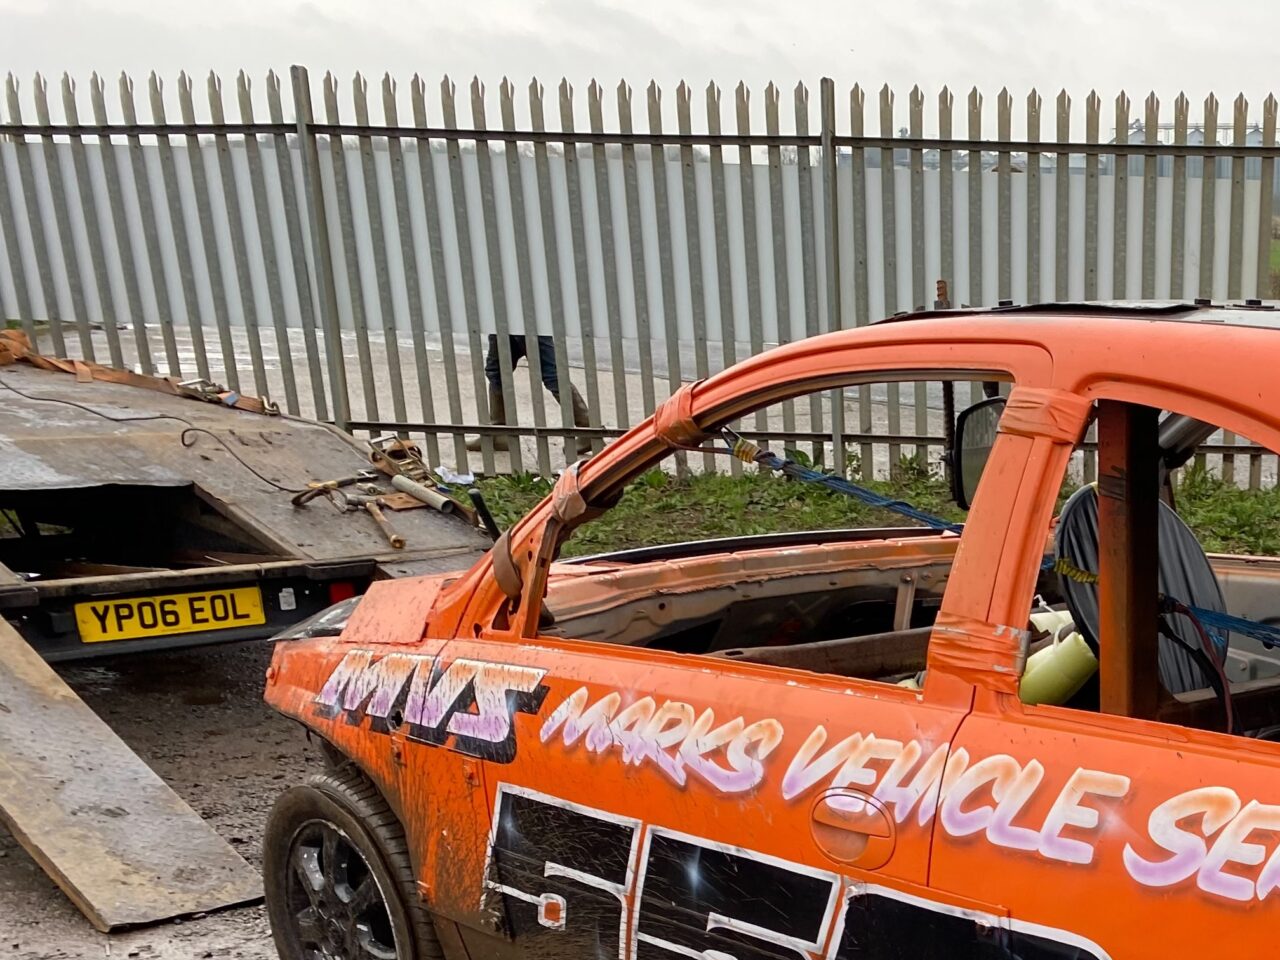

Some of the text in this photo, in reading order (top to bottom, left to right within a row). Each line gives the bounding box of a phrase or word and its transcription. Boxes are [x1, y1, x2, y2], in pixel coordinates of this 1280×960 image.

[90, 592, 251, 634] YP06 EOL
[314, 649, 550, 760] MVS
[539, 686, 785, 793] MARKS
[781, 724, 1131, 865] VEHICLE
